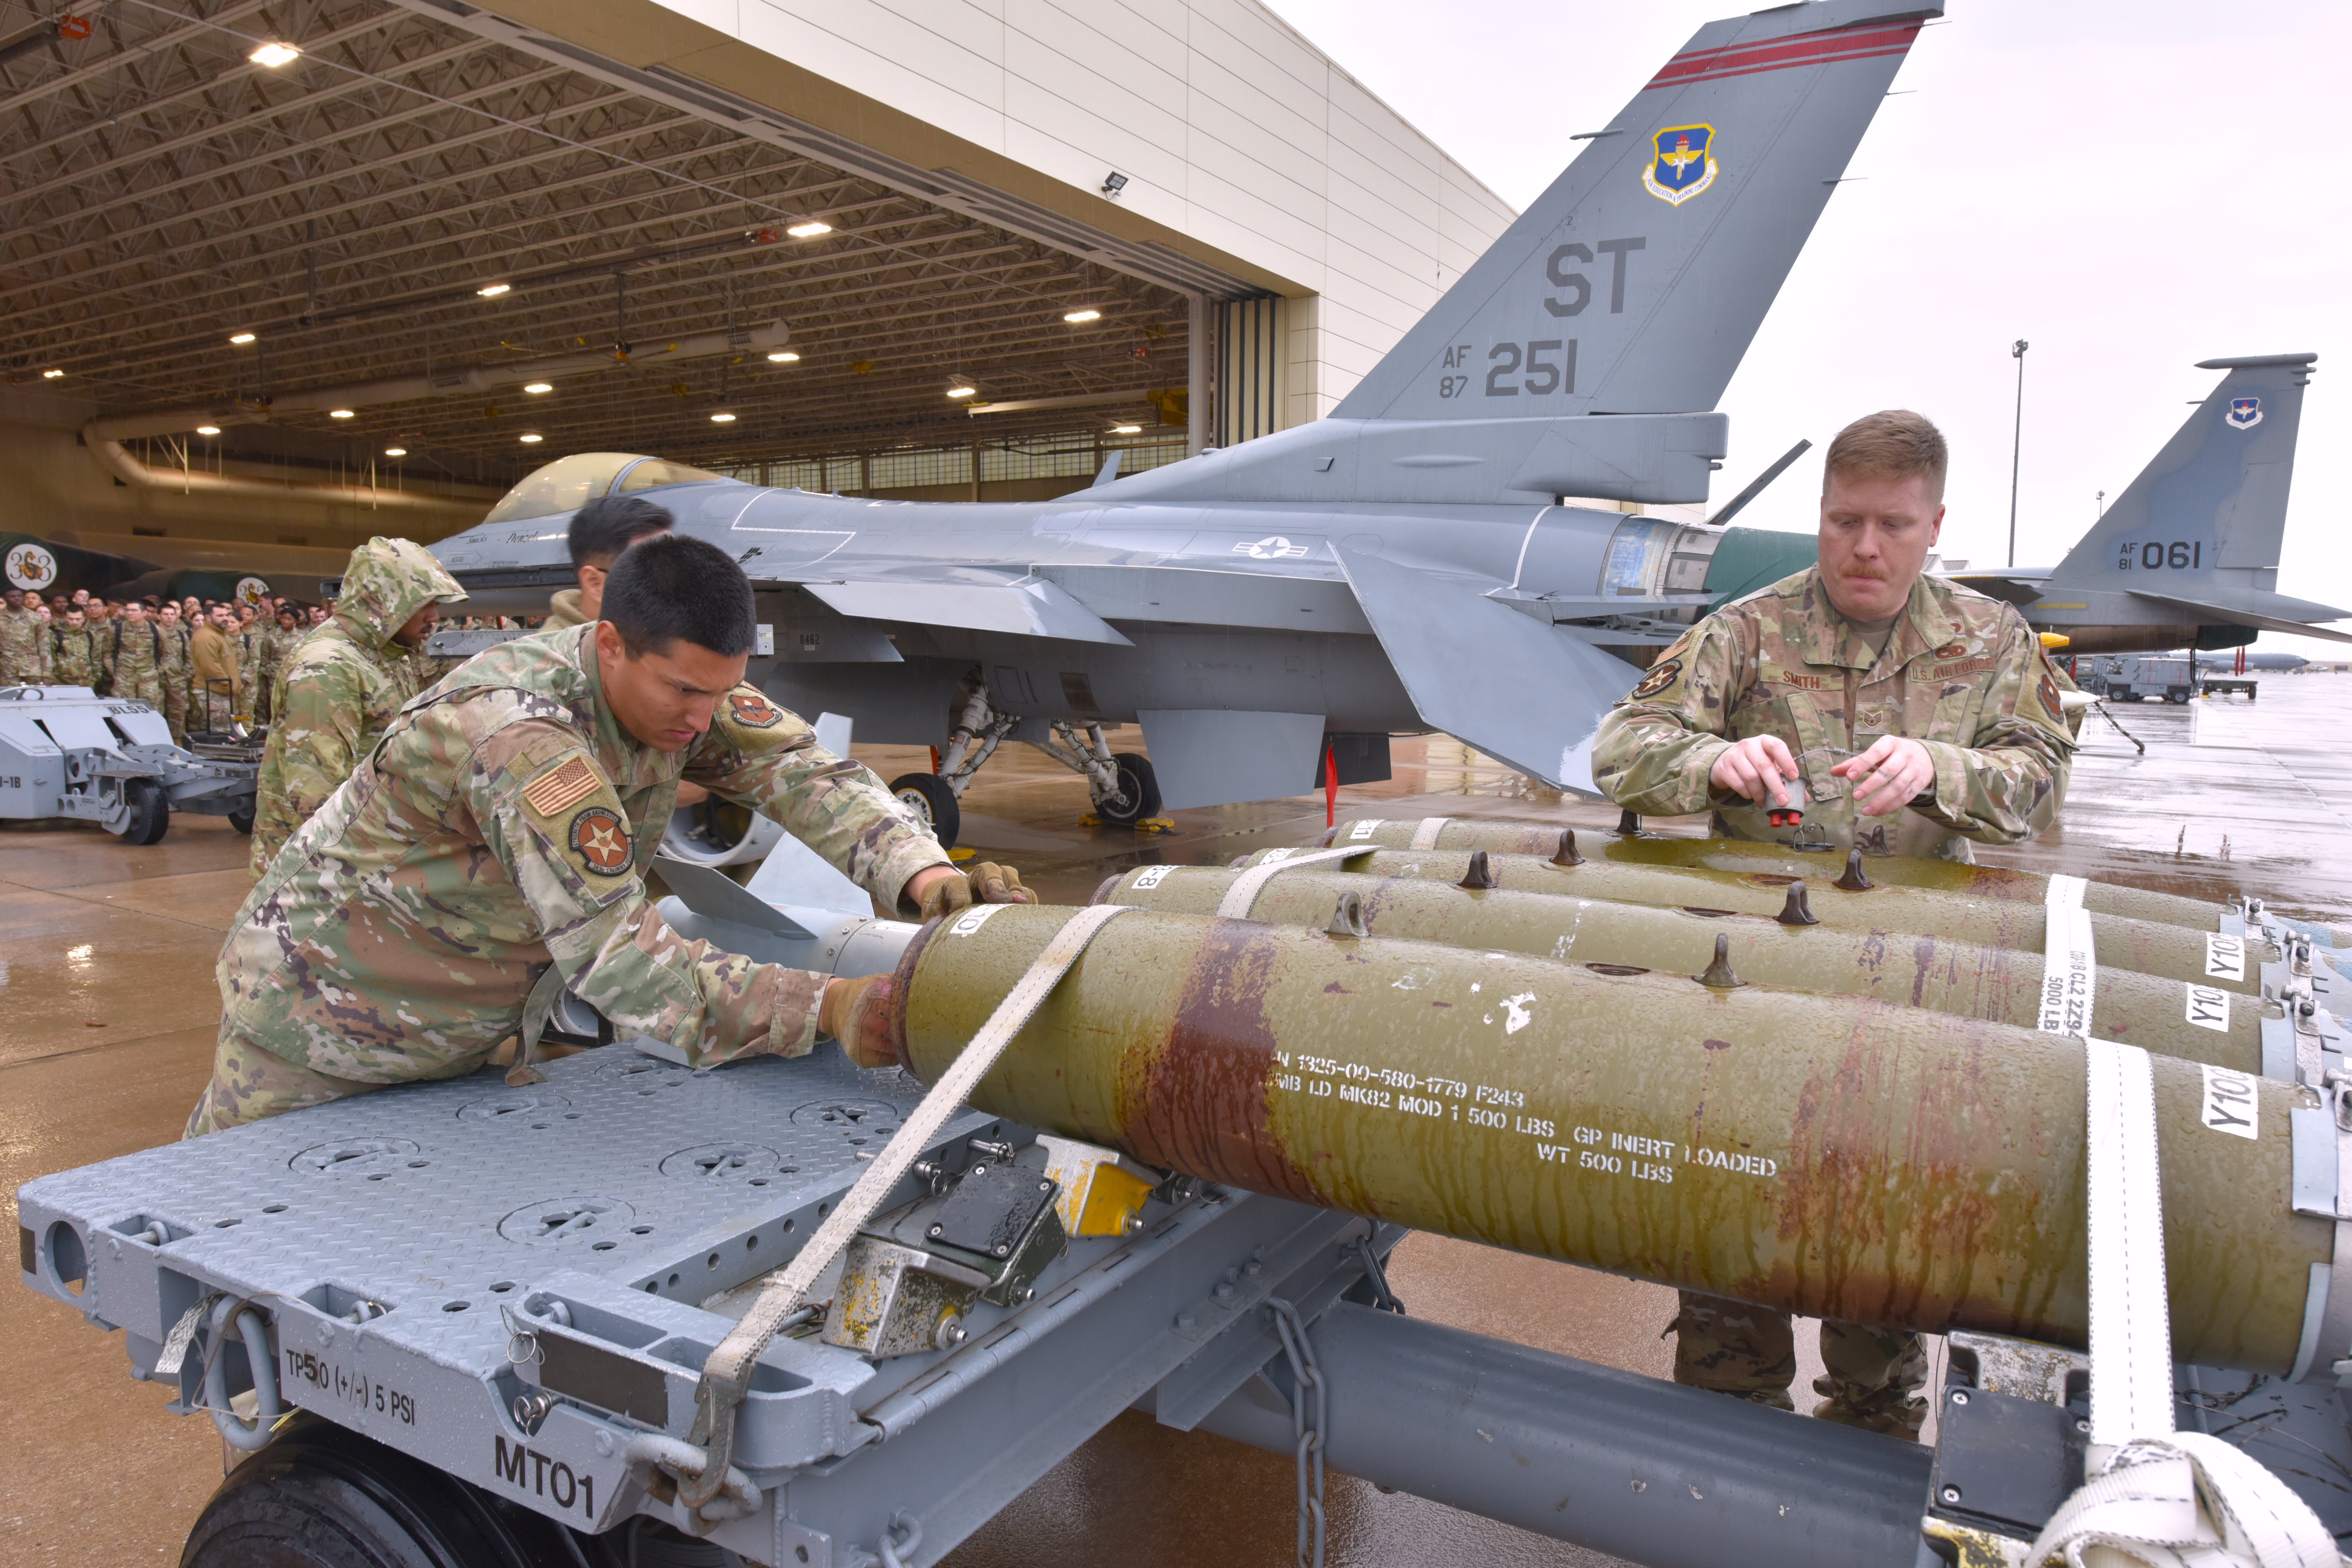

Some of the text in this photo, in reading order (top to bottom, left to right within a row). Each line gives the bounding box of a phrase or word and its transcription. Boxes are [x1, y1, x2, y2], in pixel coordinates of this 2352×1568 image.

[1652, 184, 1673, 200] EDUCATION
[1676, 187, 1694, 203] TRAINING
[1694, 172, 1712, 192] COMMAND
[1544, 236, 1646, 318] ST
[1441, 345, 1472, 369] AF
[1485, 339, 1578, 397] 251
[1439, 375, 1469, 398] 87
[466, 535, 488, 545] Snacks
[506, 531, 539, 544] Denzel
[2120, 542, 2138, 554] AF
[2119, 558, 2132, 570] 81
[2142, 541, 2201, 569] 061
[800, 634, 820, 645] 0462
[1783, 670, 1820, 689] SMITH
[1912, 657, 1993, 681] U.S. AIR FORCE
[108, 705, 150, 714] BL55
[572, 810, 619, 847] STRENGTH FROM KNOWLEDGE
[2046, 976, 2064, 1006] 5000
[2070, 972, 2087, 995] CL2
[1297, 1055, 1467, 1098] 1325-00-580-1779
[1476, 1085, 1524, 1108] F243
[2209, 1068, 2251, 1127] Y100
[1265, 1072, 1776, 1177] MB LD MK82 MOD 1 500 LBS GP INERT LOADED
[1537, 1142, 1673, 1183] WT 500 LBS
[286, 1349, 329, 1389] TP50
[375, 1384, 385, 1412] 5
[391, 1390, 415, 1426] PSI
